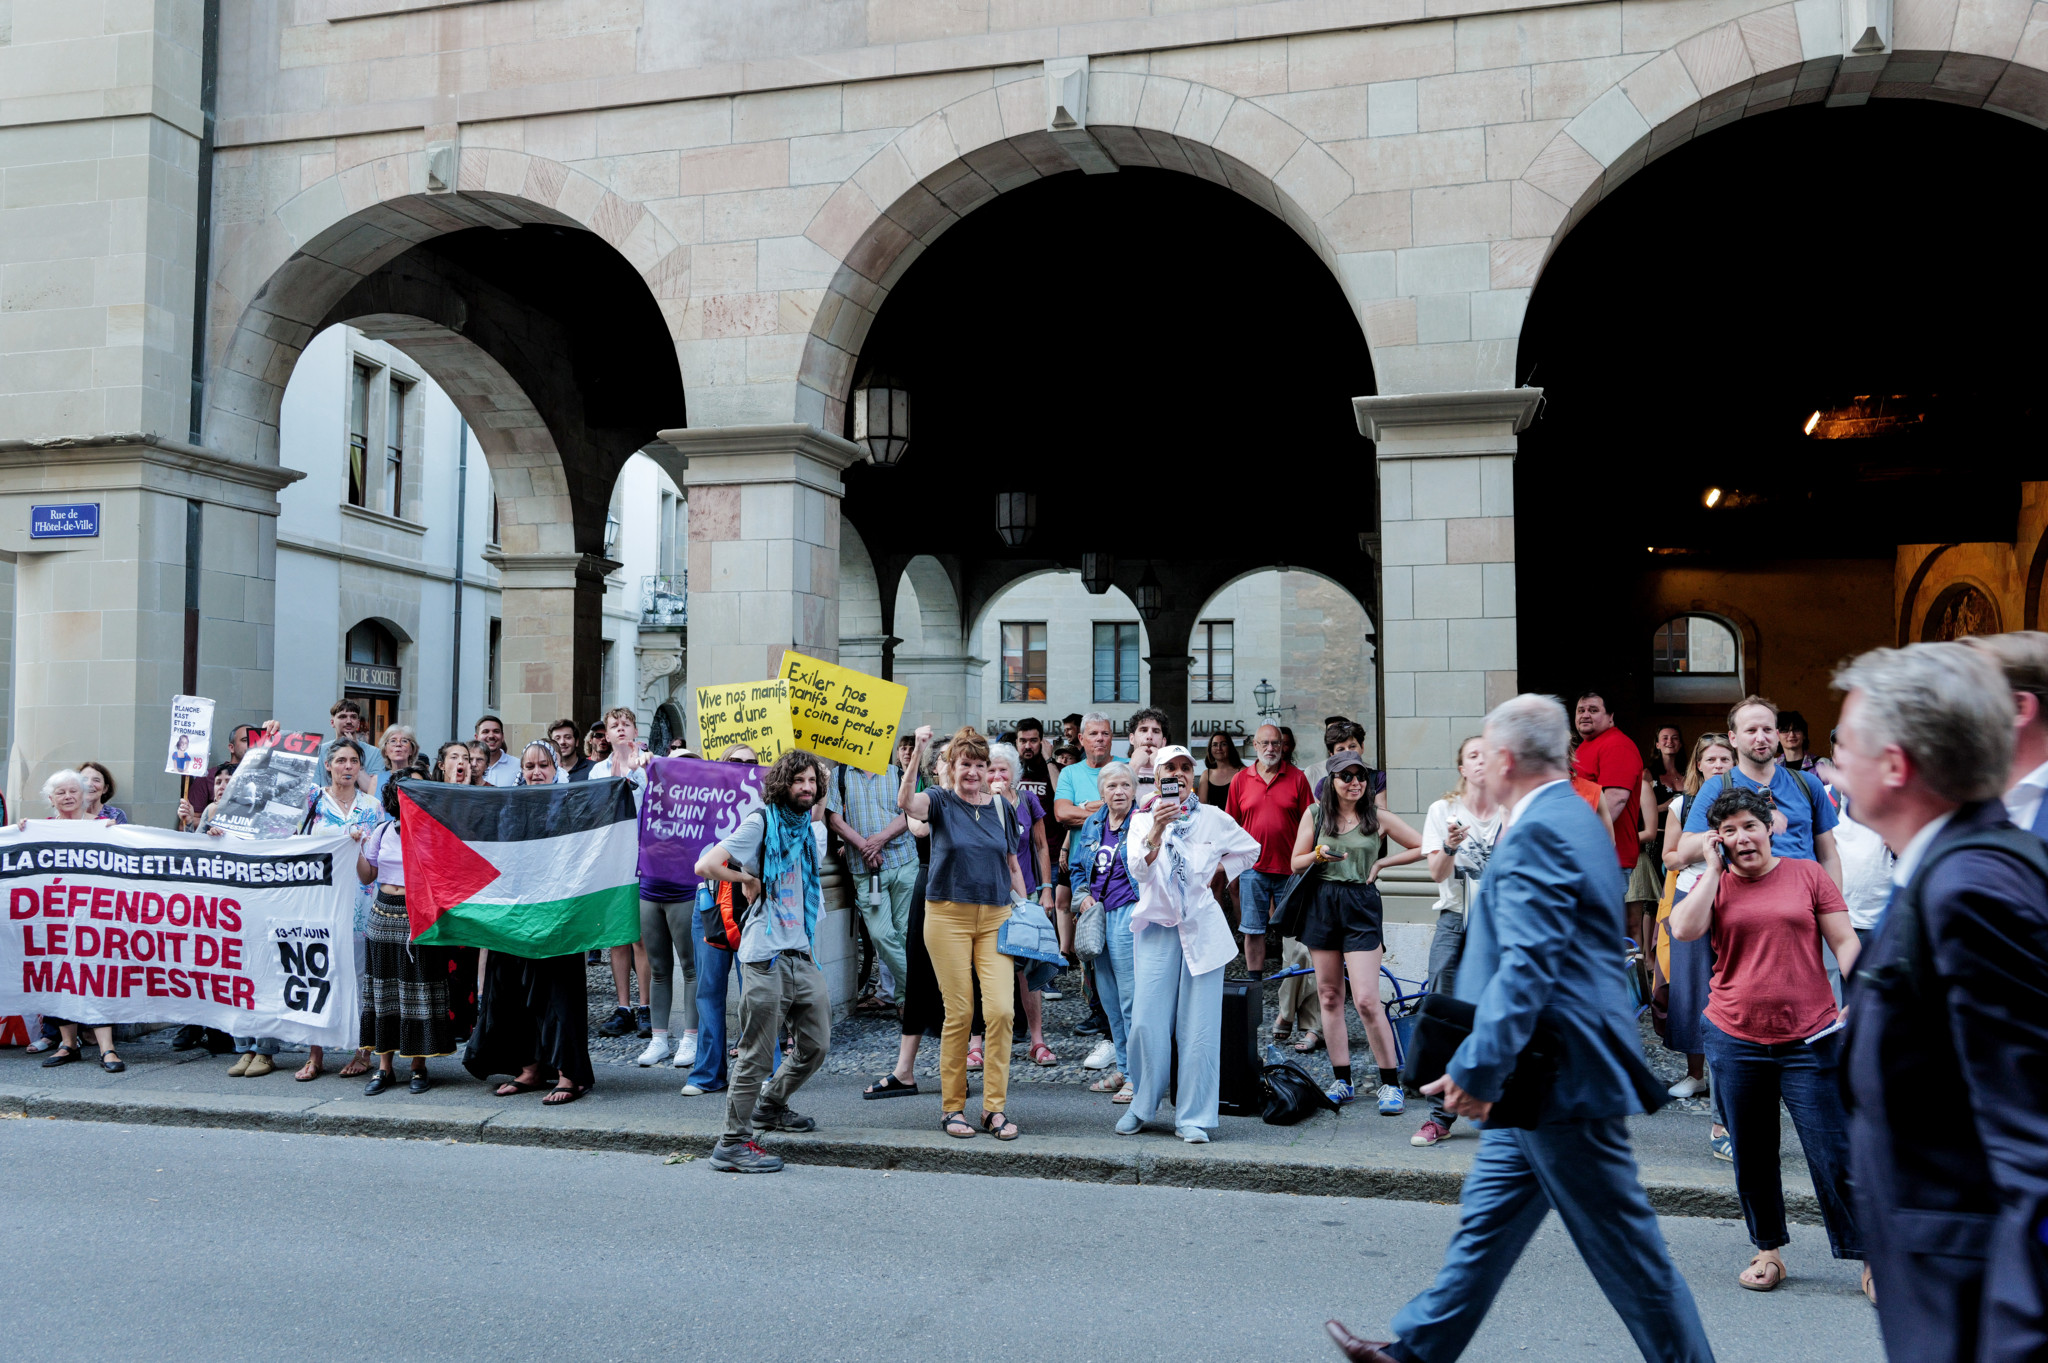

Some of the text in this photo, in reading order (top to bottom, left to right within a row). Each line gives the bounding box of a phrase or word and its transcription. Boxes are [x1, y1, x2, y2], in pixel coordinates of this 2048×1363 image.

[50, 508, 78, 519] Rue de
[35, 520, 93, 532] l'Hôtel-de-Ville
[360, 668, 369, 683] DE
[788, 662, 867, 702] Exiler nos
[698, 689, 721, 709] Vive
[726, 690, 746, 706] nos
[836, 698, 868, 717] dans
[700, 711, 727, 733] signe
[734, 703, 767, 723] d'une
[805, 708, 839, 725] coins
[284, 734, 322, 753] G7
[702, 727, 758, 750] démocratie
[761, 726, 773, 737] en
[757, 746, 772, 763] nté
[648, 781, 736, 804] 14 GIUGNO
[215, 813, 254, 826] 14 JUIN
[647, 799, 706, 821] 14 JUIN
[2, 849, 324, 882] LA CENSURE ET LA RÉPRESSION
[9, 877, 242, 932] DÉFENDONS
[275, 927, 330, 939] 13-17 JUIN
[23, 923, 243, 971] LE DROIT DE
[277, 942, 329, 978] NO
[23, 961, 255, 1010] MANIFESTER
[283, 975, 330, 1014] G7
